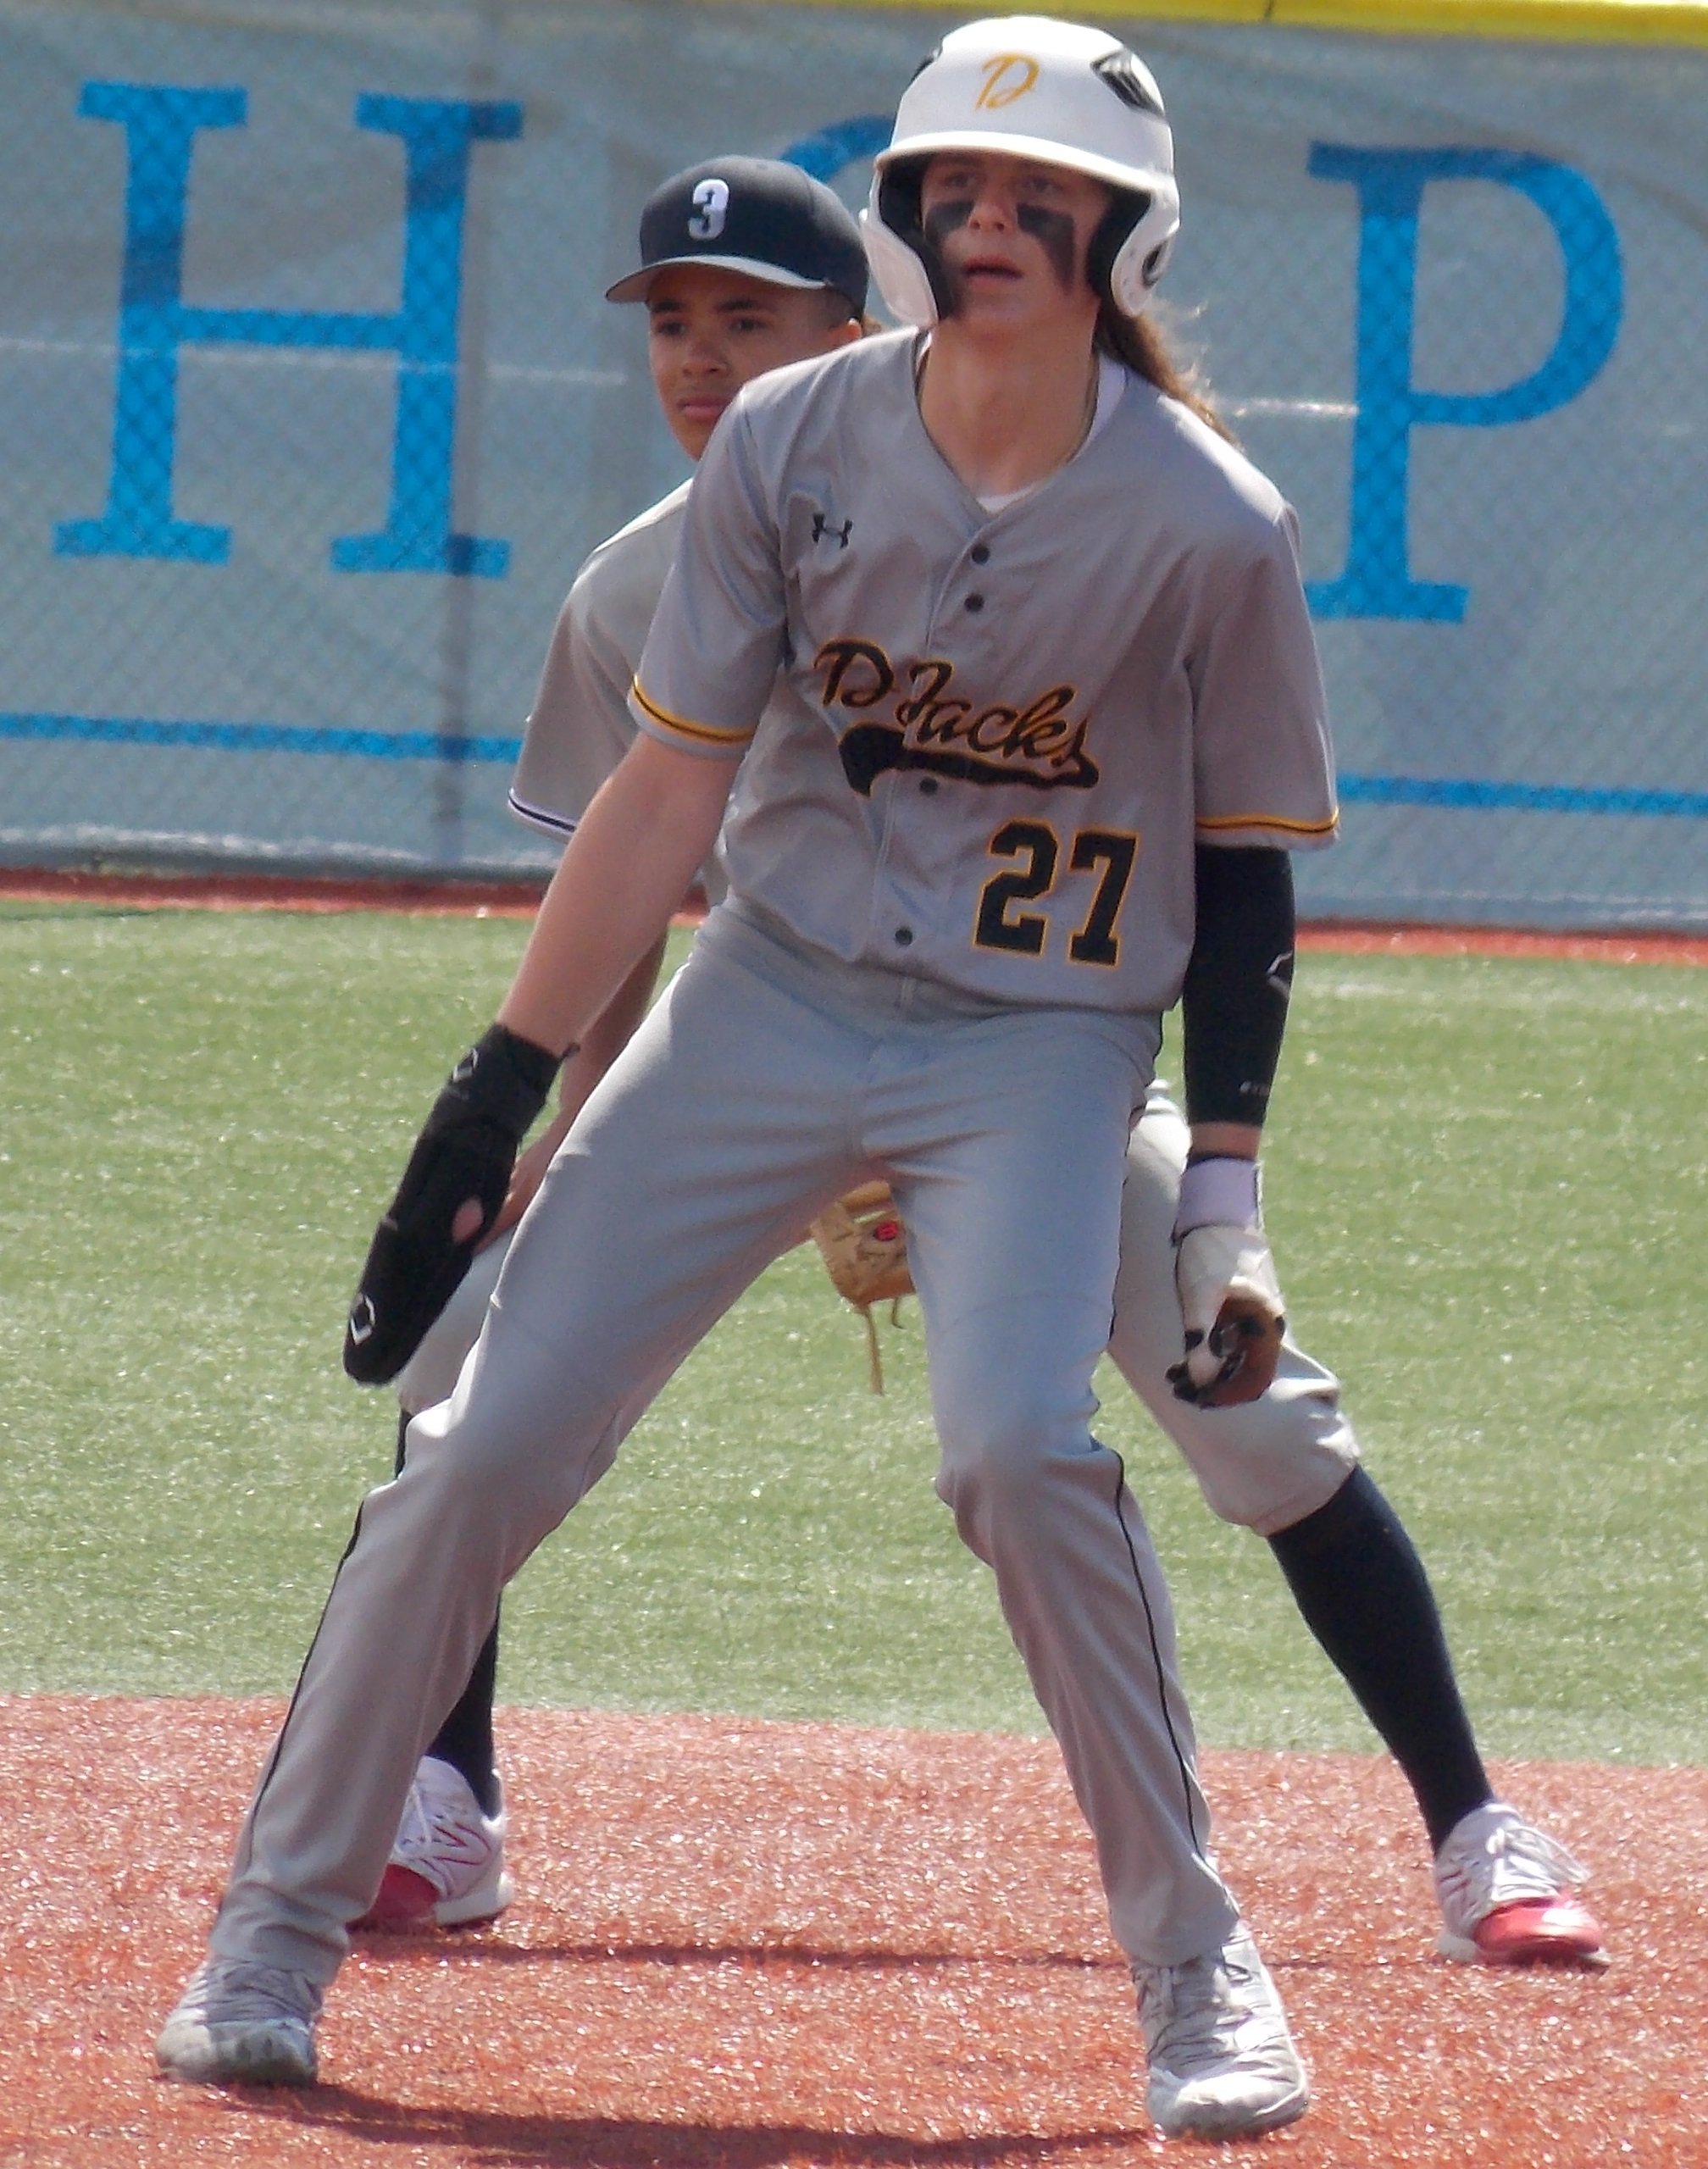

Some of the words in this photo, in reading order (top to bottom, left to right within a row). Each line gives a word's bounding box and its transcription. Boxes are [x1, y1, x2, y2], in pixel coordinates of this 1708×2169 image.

[974, 53, 1040, 110] D
[688, 178, 729, 240] 3
[973, 818, 1139, 970] 27
